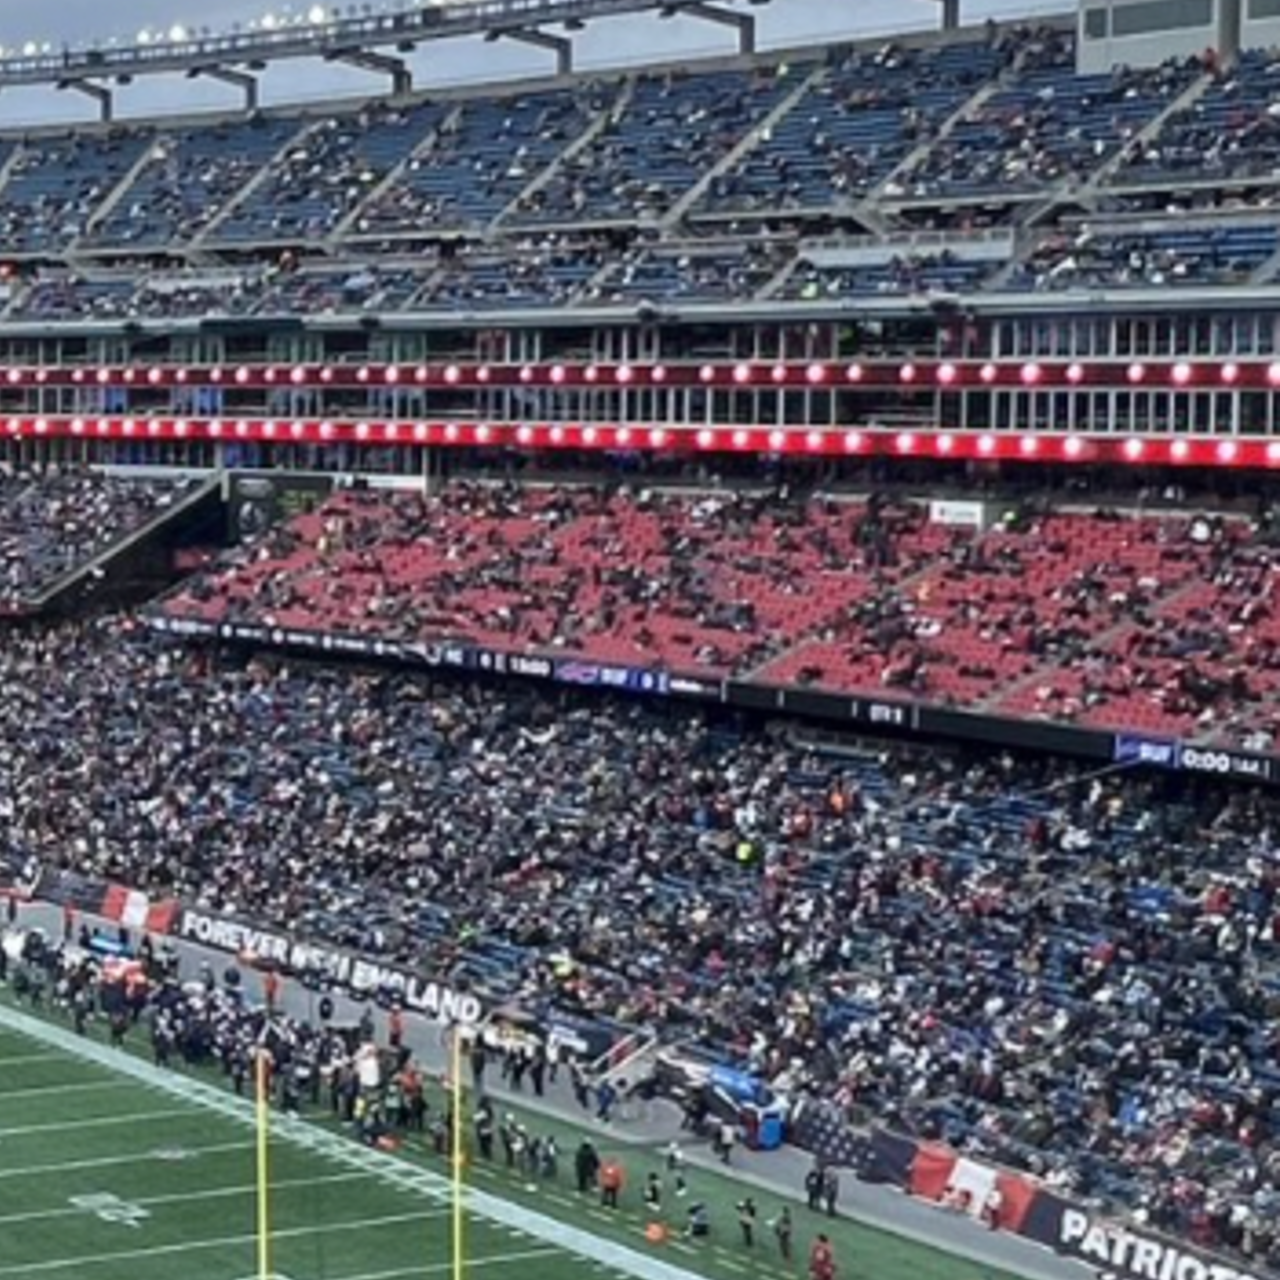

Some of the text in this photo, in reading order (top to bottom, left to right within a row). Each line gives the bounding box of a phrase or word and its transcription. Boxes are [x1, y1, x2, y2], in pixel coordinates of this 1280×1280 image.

[1182, 750, 1230, 772] 0:00
[181, 909, 289, 964] FOREVER
[351, 956, 482, 1023] ENGLAND
